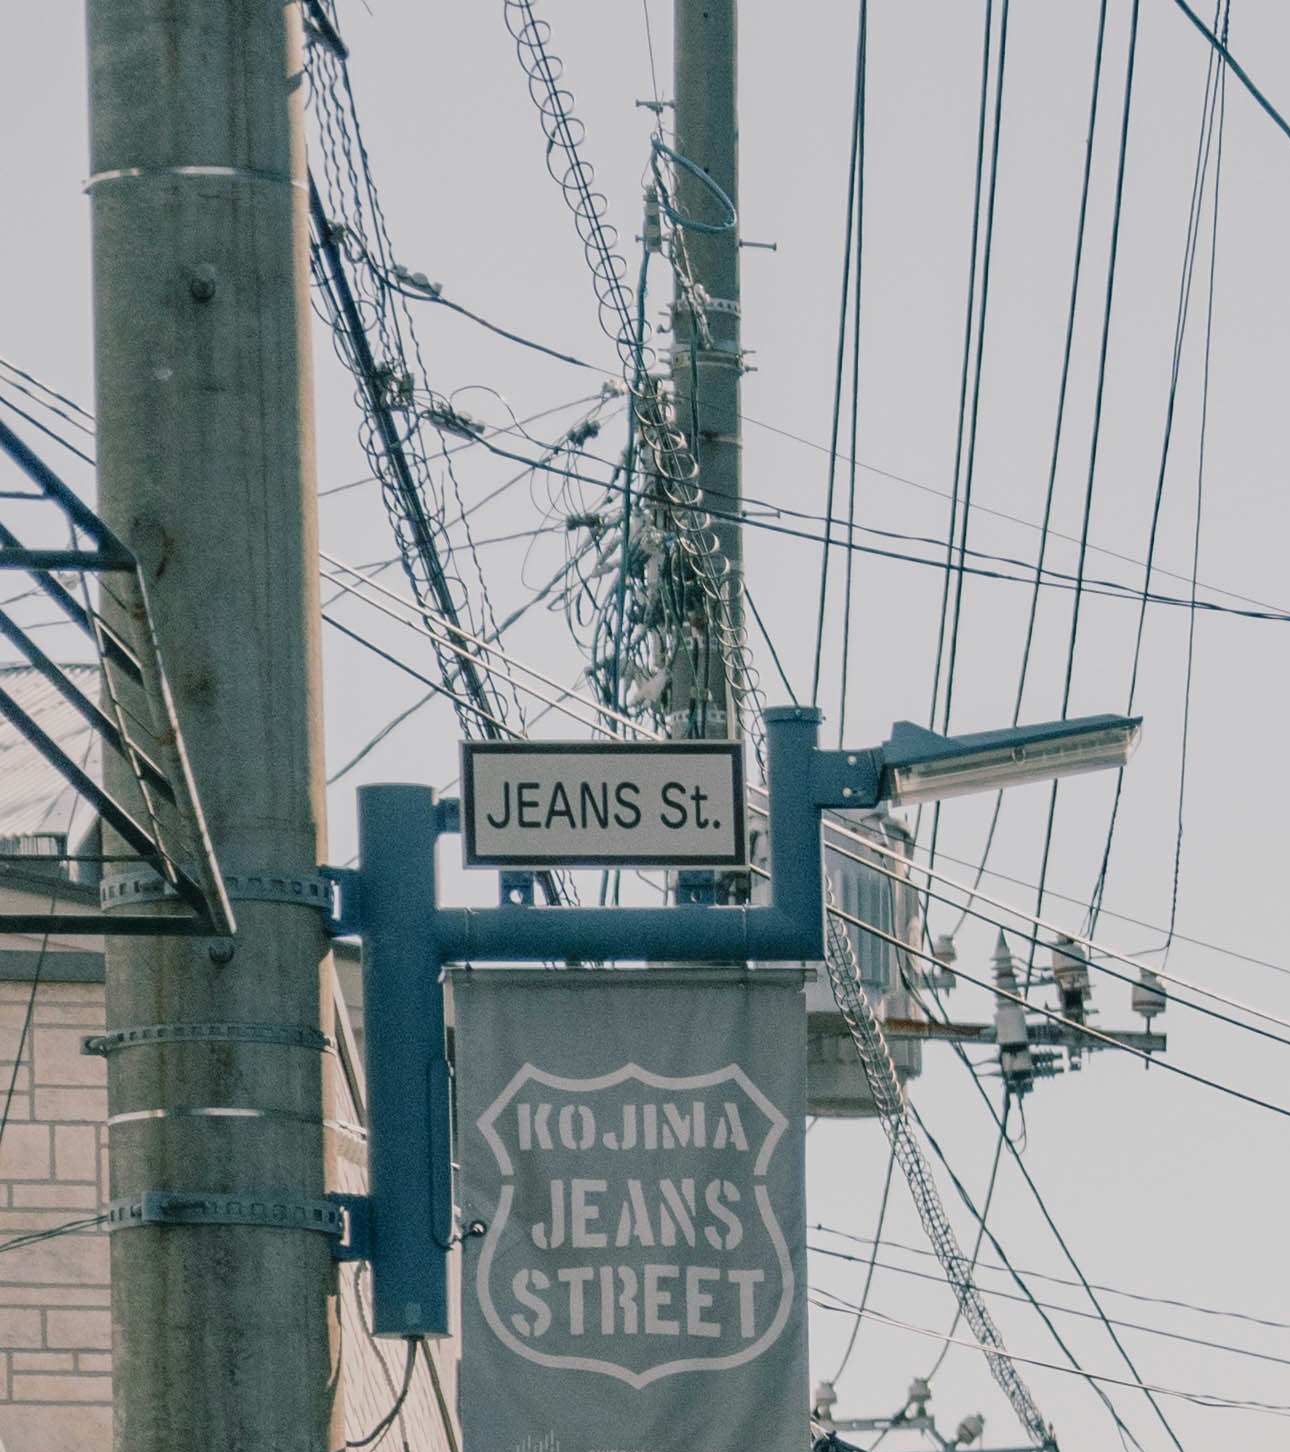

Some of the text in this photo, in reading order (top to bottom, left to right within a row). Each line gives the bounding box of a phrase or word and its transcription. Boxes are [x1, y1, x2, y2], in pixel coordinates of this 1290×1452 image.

[487, 782, 721, 829] JEANS St.
[517, 1102, 749, 1151] KOJIMA
[531, 1178, 744, 1250] JEANS
[511, 1263, 765, 1338] STREET
